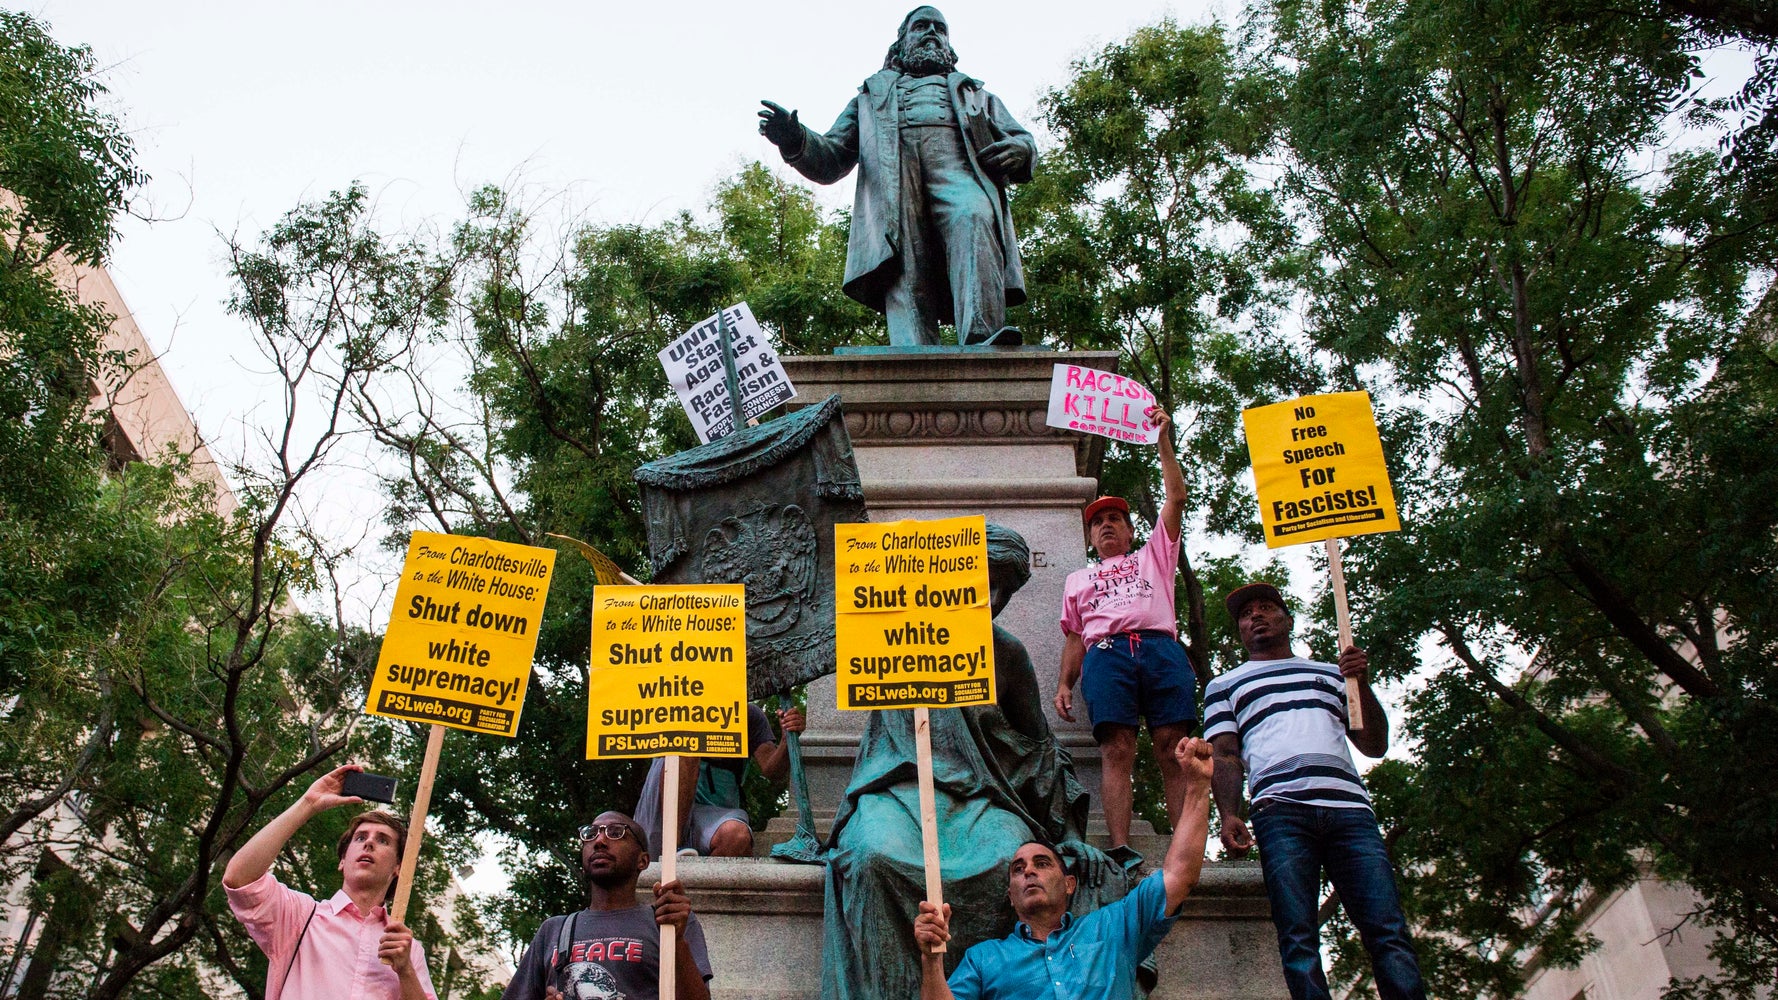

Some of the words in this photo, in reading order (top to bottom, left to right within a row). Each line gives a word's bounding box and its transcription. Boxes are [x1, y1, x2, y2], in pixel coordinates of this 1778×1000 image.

[690, 362, 758, 413] Racim
[759, 352, 774, 368] &
[700, 370, 779, 426] Fasism
[742, 384, 787, 411] CONGRESS
[1294, 406, 1315, 421] No
[720, 426, 730, 437] OF
[1292, 425, 1327, 441] Free
[1283, 442, 1345, 464] Speech
[1300, 466, 1336, 488] For
[1272, 486, 1377, 522] Fascists!
[1306, 518, 1334, 528] Socialism
[1347, 512, 1376, 521] Liberation
[846, 538, 877, 552] From
[882, 528, 981, 551] Charlottesville
[418, 546, 446, 559] From
[450, 547, 547, 578] Charlottesville
[850, 563, 859, 573] to
[864, 560, 880, 573] the
[885, 555, 924, 574] White
[929, 555, 978, 573] House:
[413, 571, 424, 581] to
[427, 570, 444, 584] the
[446, 570, 485, 592] White
[488, 576, 539, 601] House:
[854, 585, 906, 609] Shut
[915, 584, 977, 608] down
[604, 598, 635, 610] From
[640, 594, 739, 610] Charlottesville
[409, 595, 460, 619] Shut
[466, 604, 527, 635] down
[606, 620, 616, 630] to
[621, 618, 637, 630] the
[642, 615, 682, 632] White
[686, 615, 736, 631] House:
[884, 621, 950, 646] white
[429, 639, 490, 667] white
[609, 642, 662, 665] Shut
[670, 641, 733, 662] down
[850, 646, 986, 680] supremacy!
[387, 664, 520, 705] supremacy!
[638, 675, 704, 699] white
[855, 685, 947, 702] PSLweb.org
[954, 688, 982, 696] SOCIALISM
[384, 694, 472, 723] PSLweb.org
[955, 694, 984, 702] LIBERATION
[479, 715, 506, 724] SOCIALISM
[480, 709, 496, 717] PARTY
[601, 701, 740, 731] supremacy!
[477, 722, 505, 730] LIBERATION
[606, 734, 698, 751] PSLweb.org
